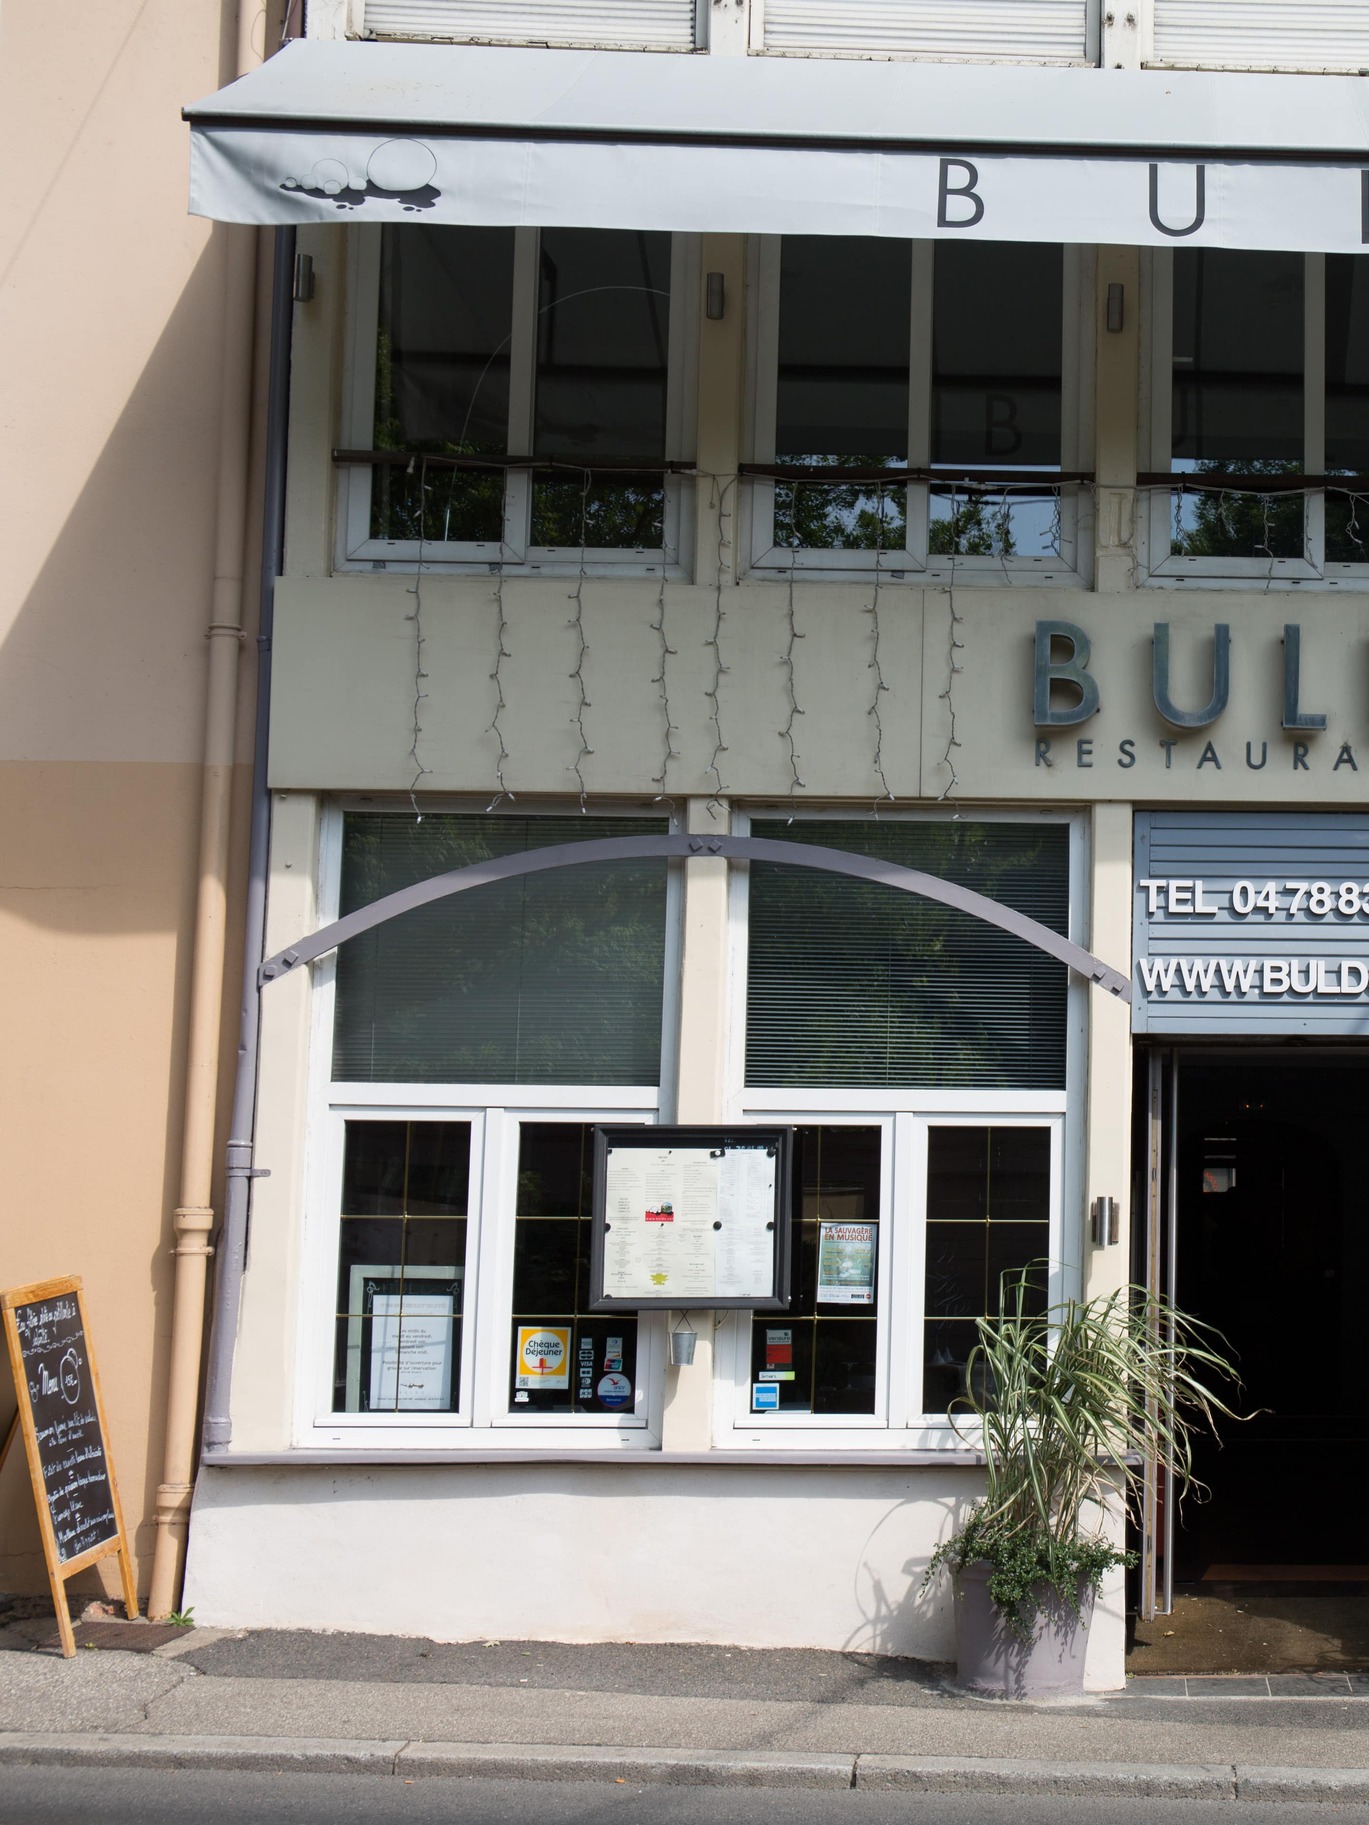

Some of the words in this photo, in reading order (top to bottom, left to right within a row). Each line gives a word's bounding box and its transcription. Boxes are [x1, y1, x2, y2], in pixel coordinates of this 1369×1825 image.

[1139, 878, 1219, 915] TEL
[824, 1226, 833, 1234] LA
[824, 1233, 834, 1241] EN
[836, 1234, 873, 1242] MUSIQUE
[528, 1340, 560, 1349] Chèque
[525, 1347, 563, 1358] Déjeuner
